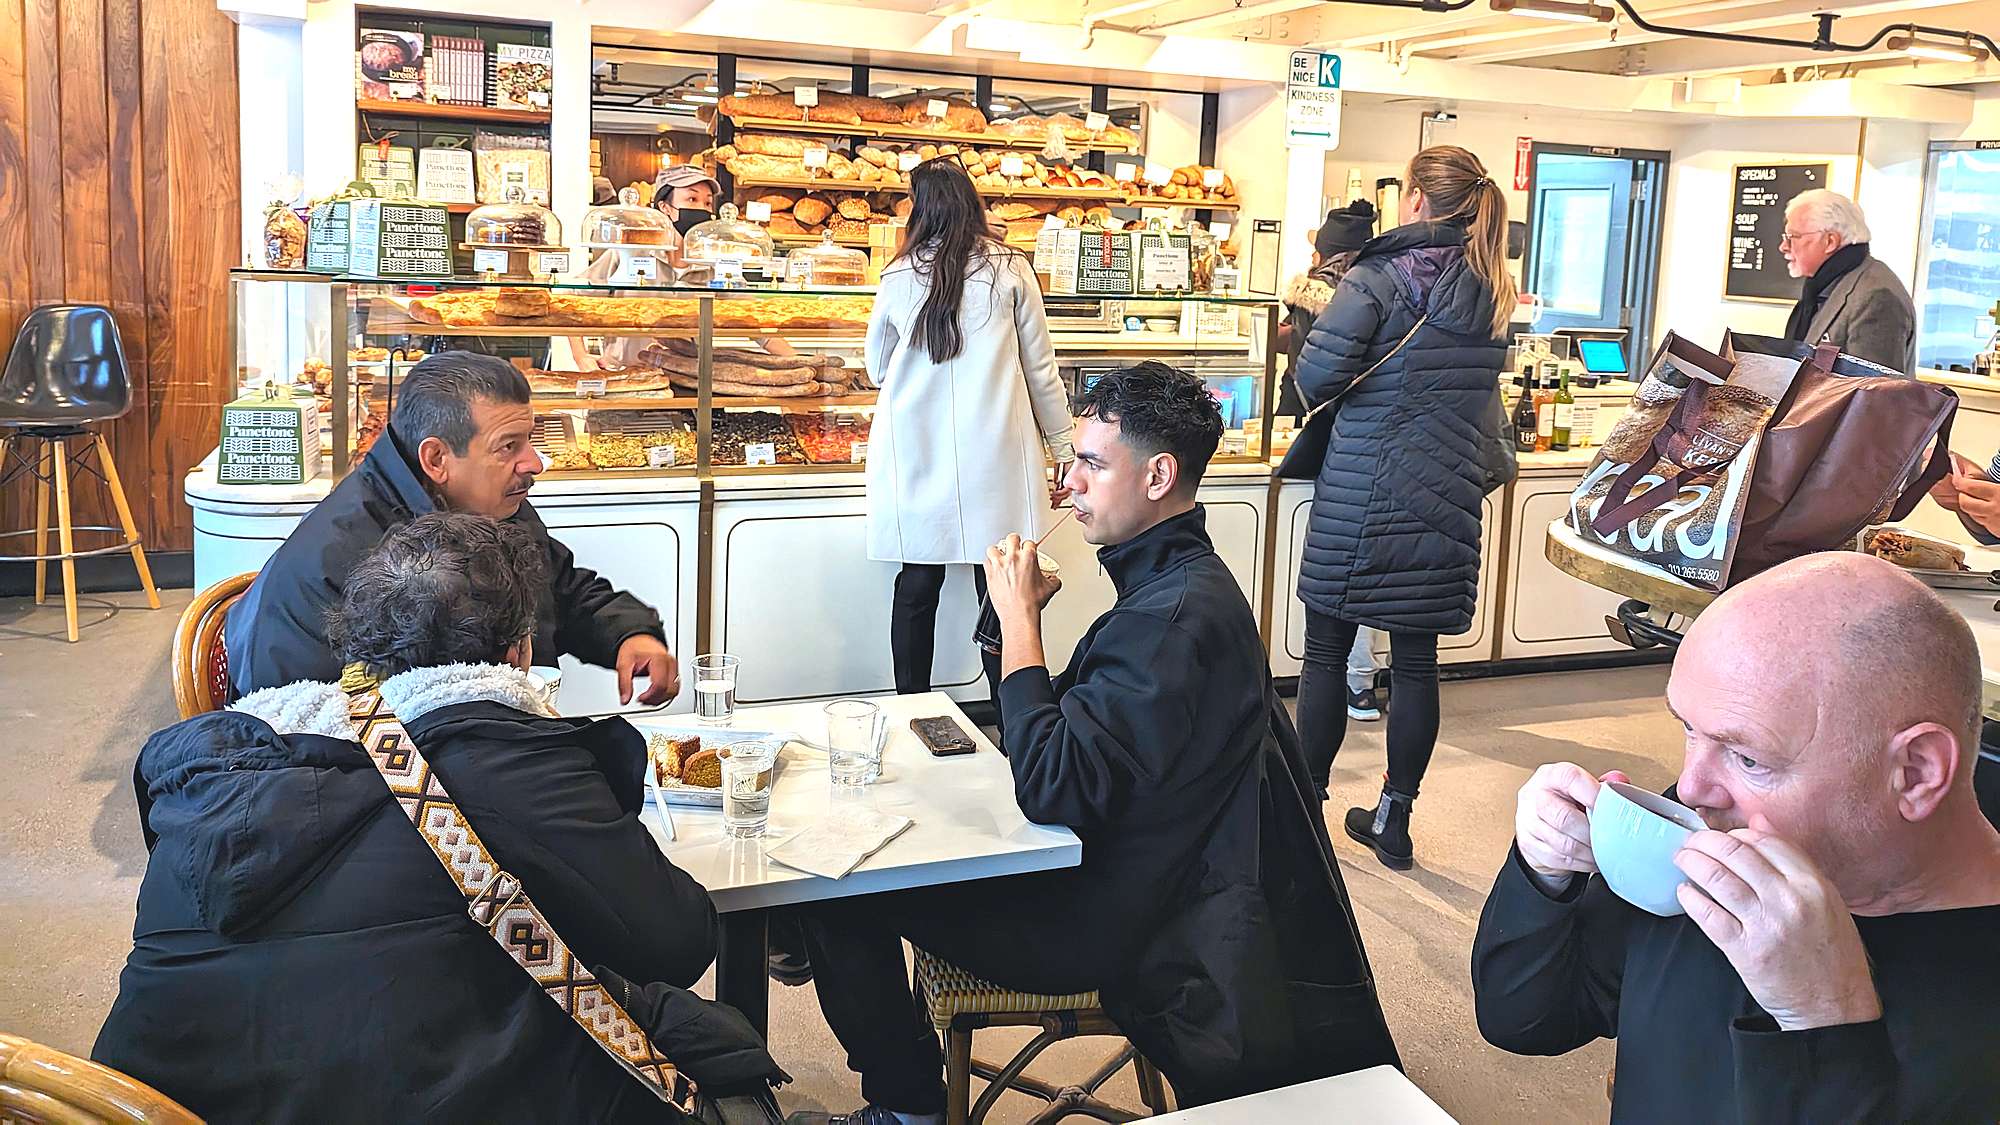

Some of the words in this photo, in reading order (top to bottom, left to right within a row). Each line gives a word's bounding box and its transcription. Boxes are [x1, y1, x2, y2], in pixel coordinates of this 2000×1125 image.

[518, 47, 552, 60] PIZZA
[1293, 57, 1307, 69] BE
[389, 69, 419, 79] bread
[402, 66, 417, 74] my
[1320, 57, 1338, 85] K
[1292, 71, 1316, 82] NICE
[1291, 89, 1335, 102] KINDNESS
[1300, 105, 1324, 117] ZONE
[1739, 168, 1777, 181] SPECIALS
[1735, 213, 1759, 225] SOUP
[386, 222, 444, 234] Panettone
[385, 247, 446, 259] Panettone
[1084, 247, 1129, 257] Panone
[1083, 269, 1129, 279] Panettone
[229, 426, 295, 438] Panettone
[226, 452, 296, 465] Panettone
